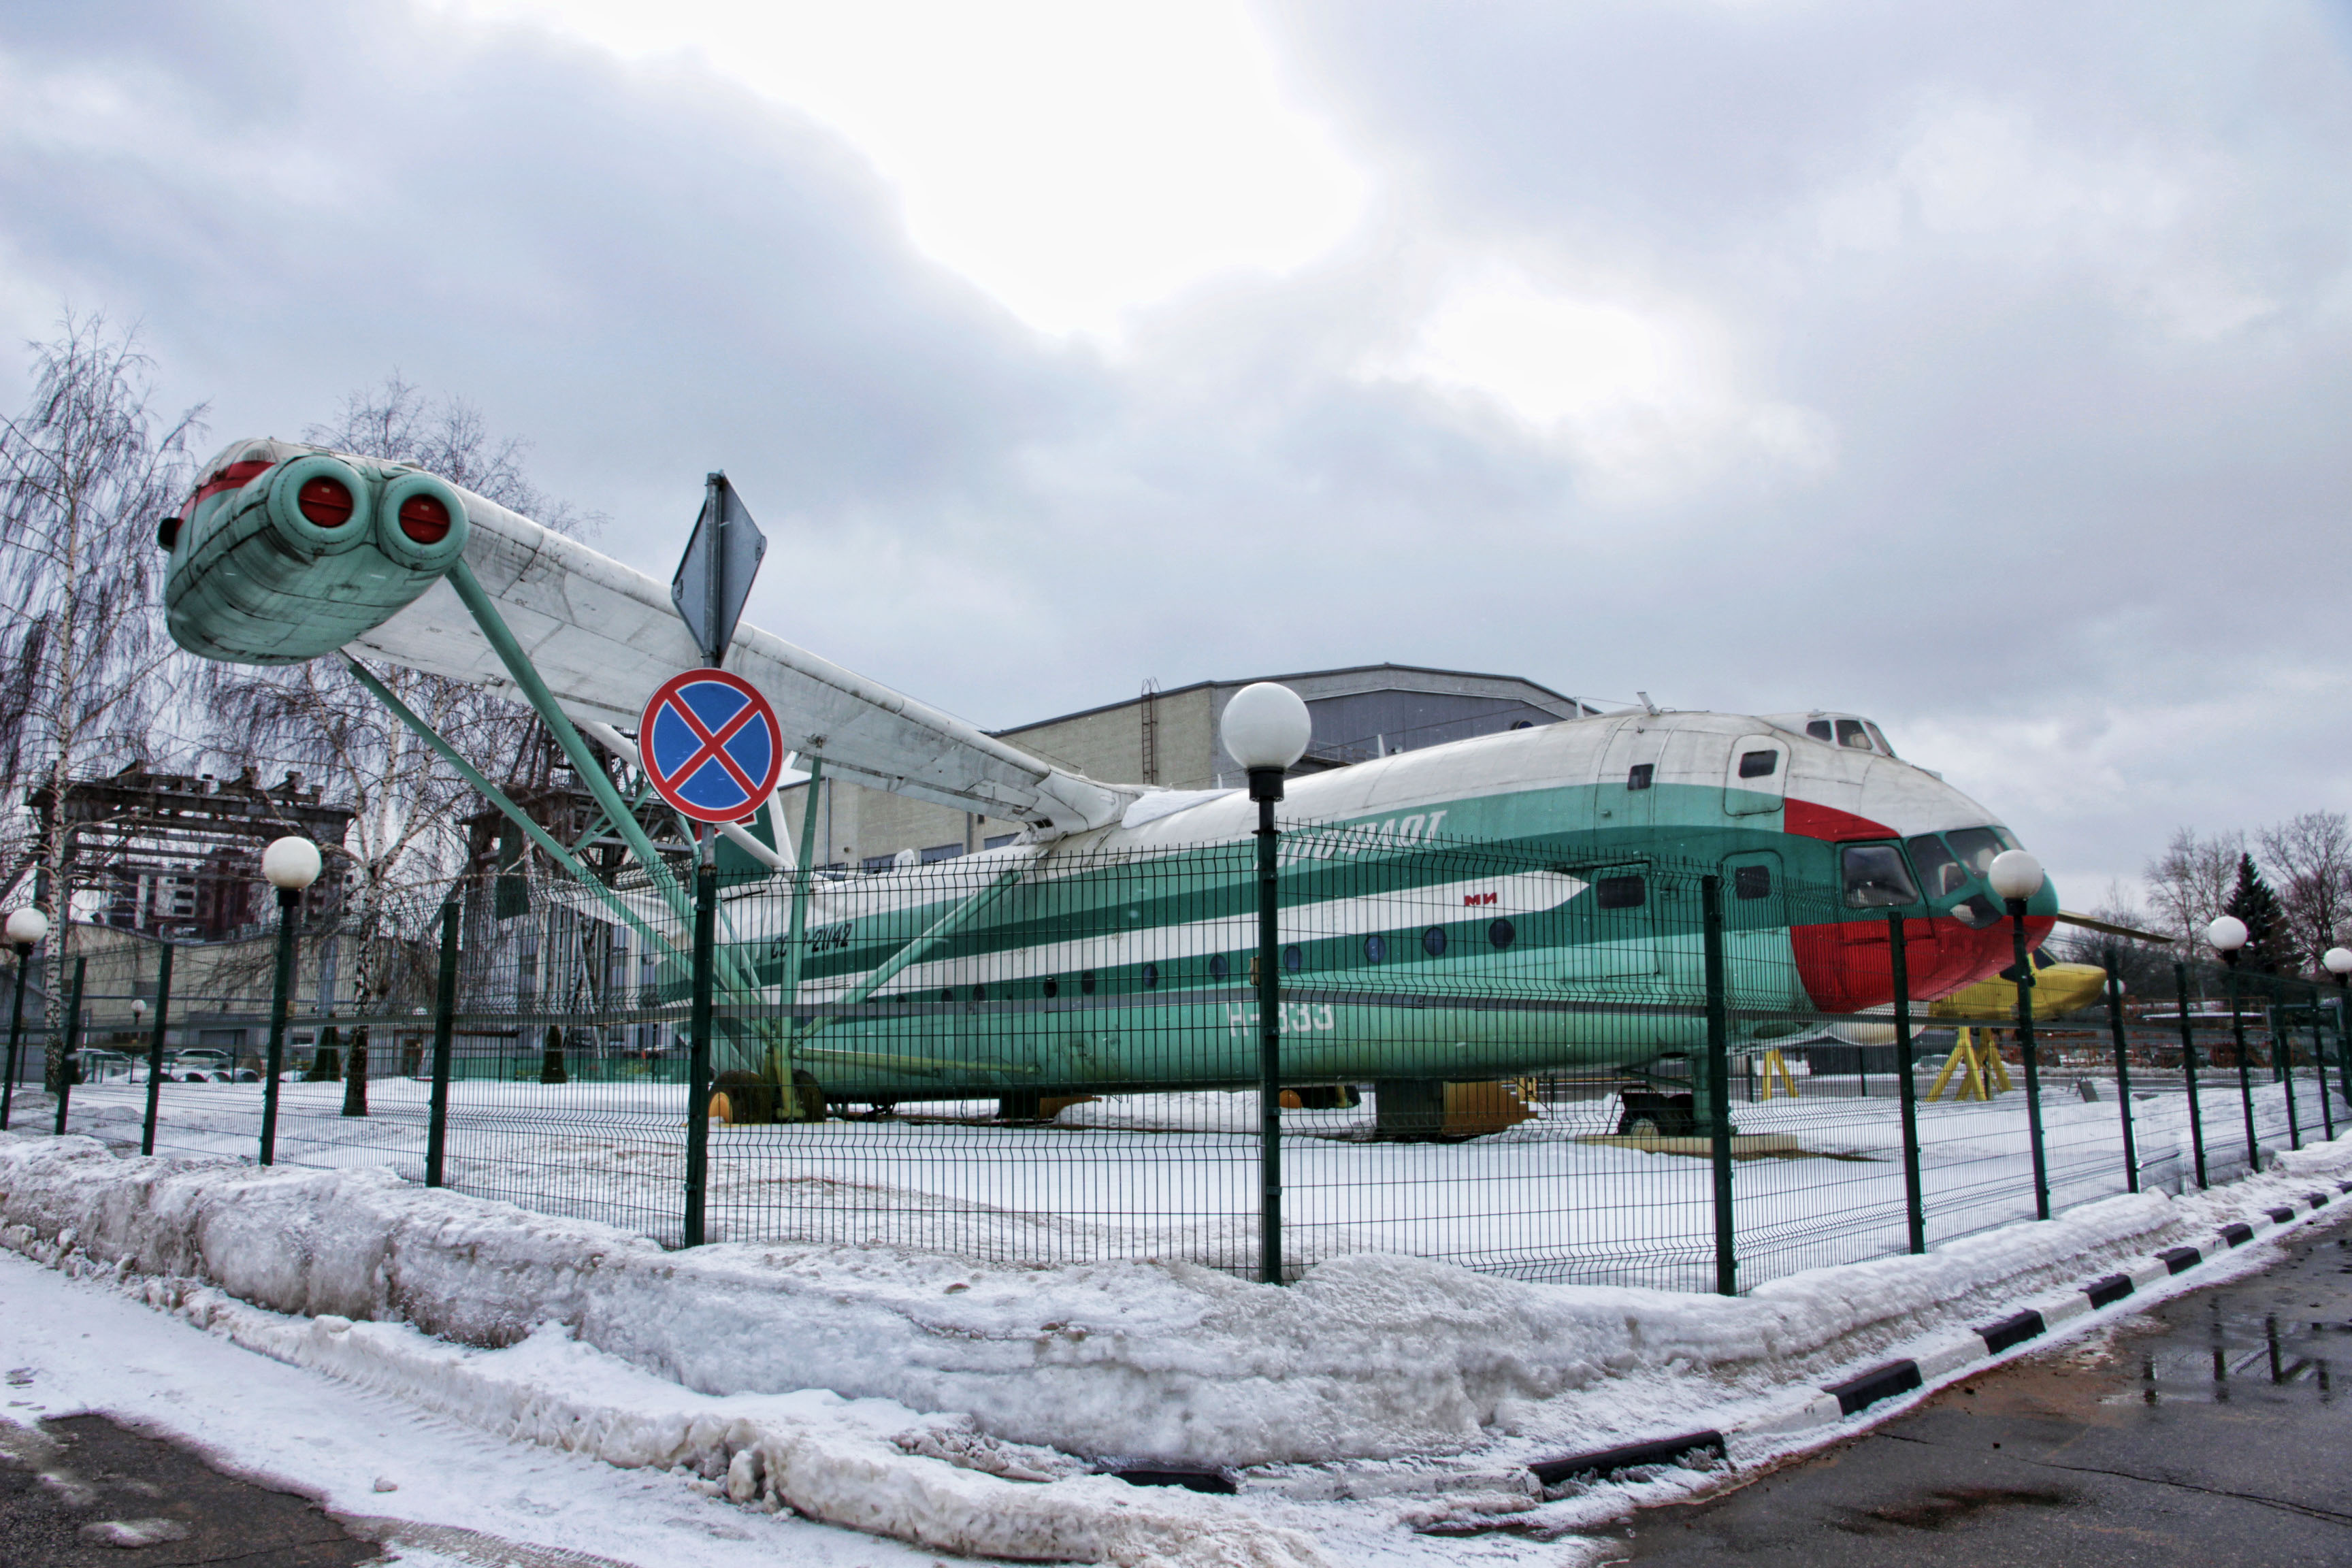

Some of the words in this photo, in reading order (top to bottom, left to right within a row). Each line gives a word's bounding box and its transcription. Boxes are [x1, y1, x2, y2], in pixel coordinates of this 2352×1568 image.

[1254, 810, 1448, 869] ЭРОФЛОТ
[1465, 892, 1497, 906] МИ
[771, 923, 853, 959] СС-21142
